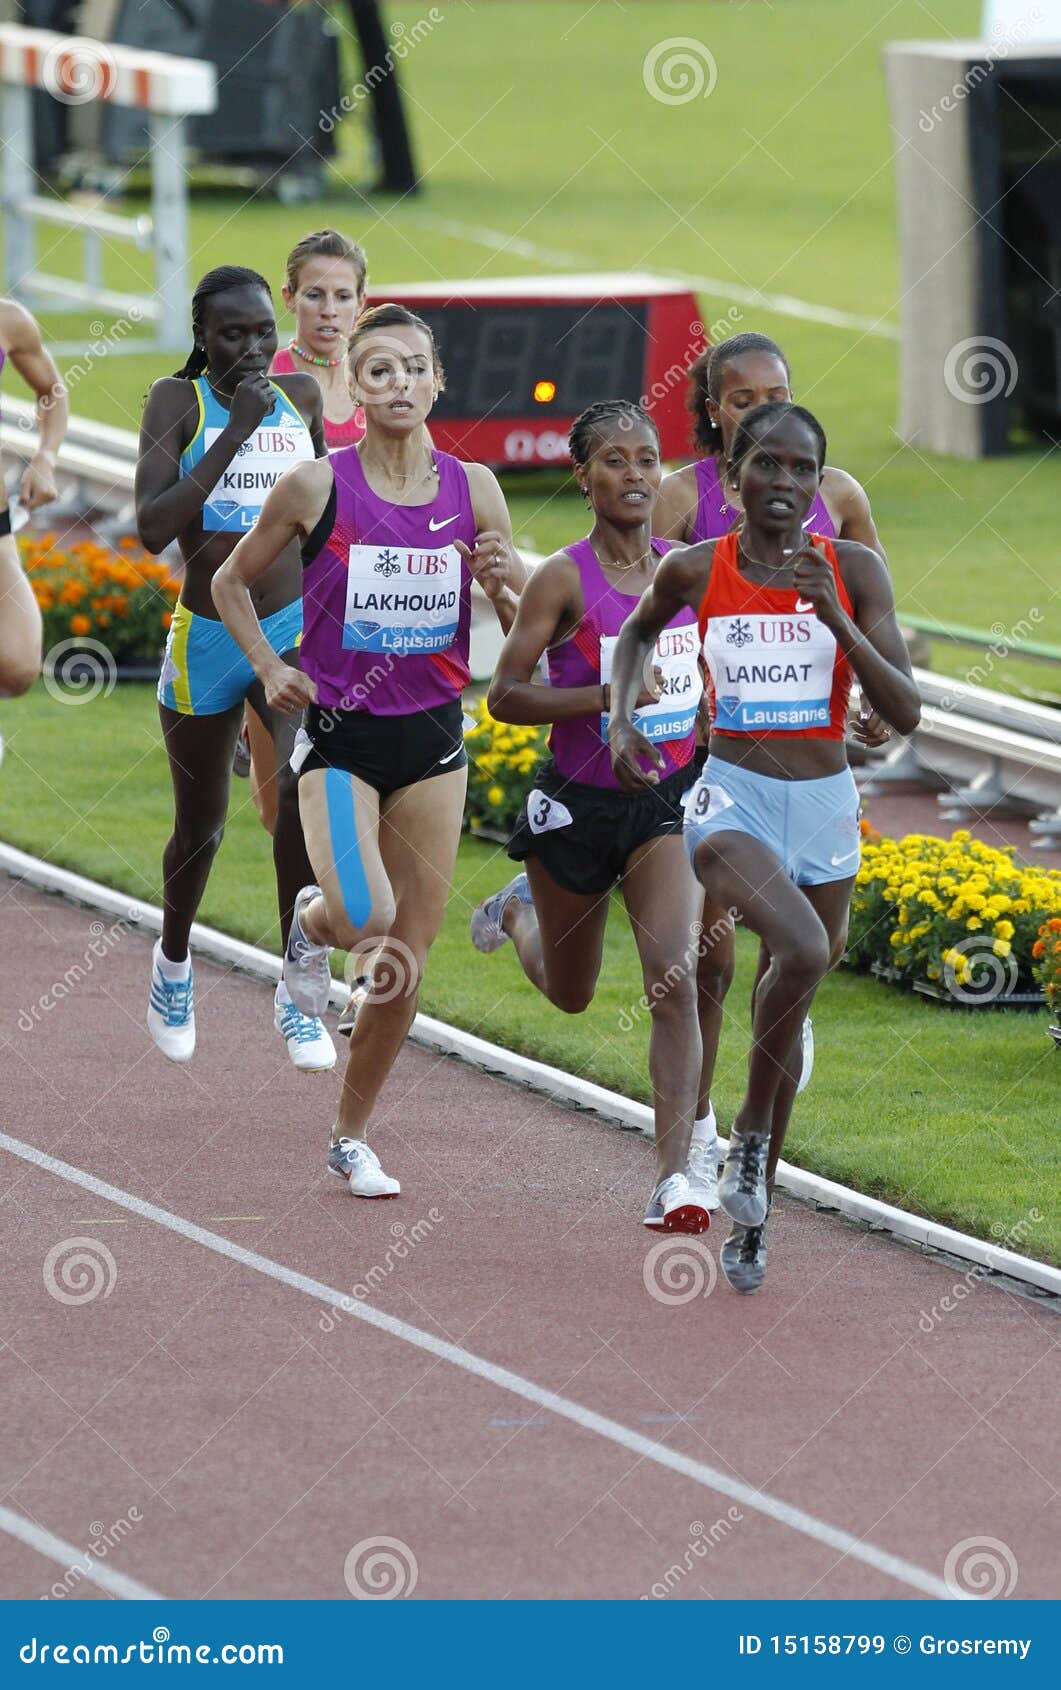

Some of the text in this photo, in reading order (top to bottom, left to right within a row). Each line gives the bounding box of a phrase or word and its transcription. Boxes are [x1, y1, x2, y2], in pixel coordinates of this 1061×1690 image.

[257, 432, 296, 453] UBS
[223, 472, 284, 489] KIBIW
[407, 553, 448, 576] UBS
[353, 591, 456, 611] LAKHOUAD
[381, 632, 455, 649] Lausanne
[760, 621, 811, 643] UBS
[656, 631, 695, 657] UBS
[726, 664, 812, 684] LANGAT
[742, 707, 827, 724] Lausanne
[695, 787, 710, 816] 9
[533, 798, 551, 827] 3
